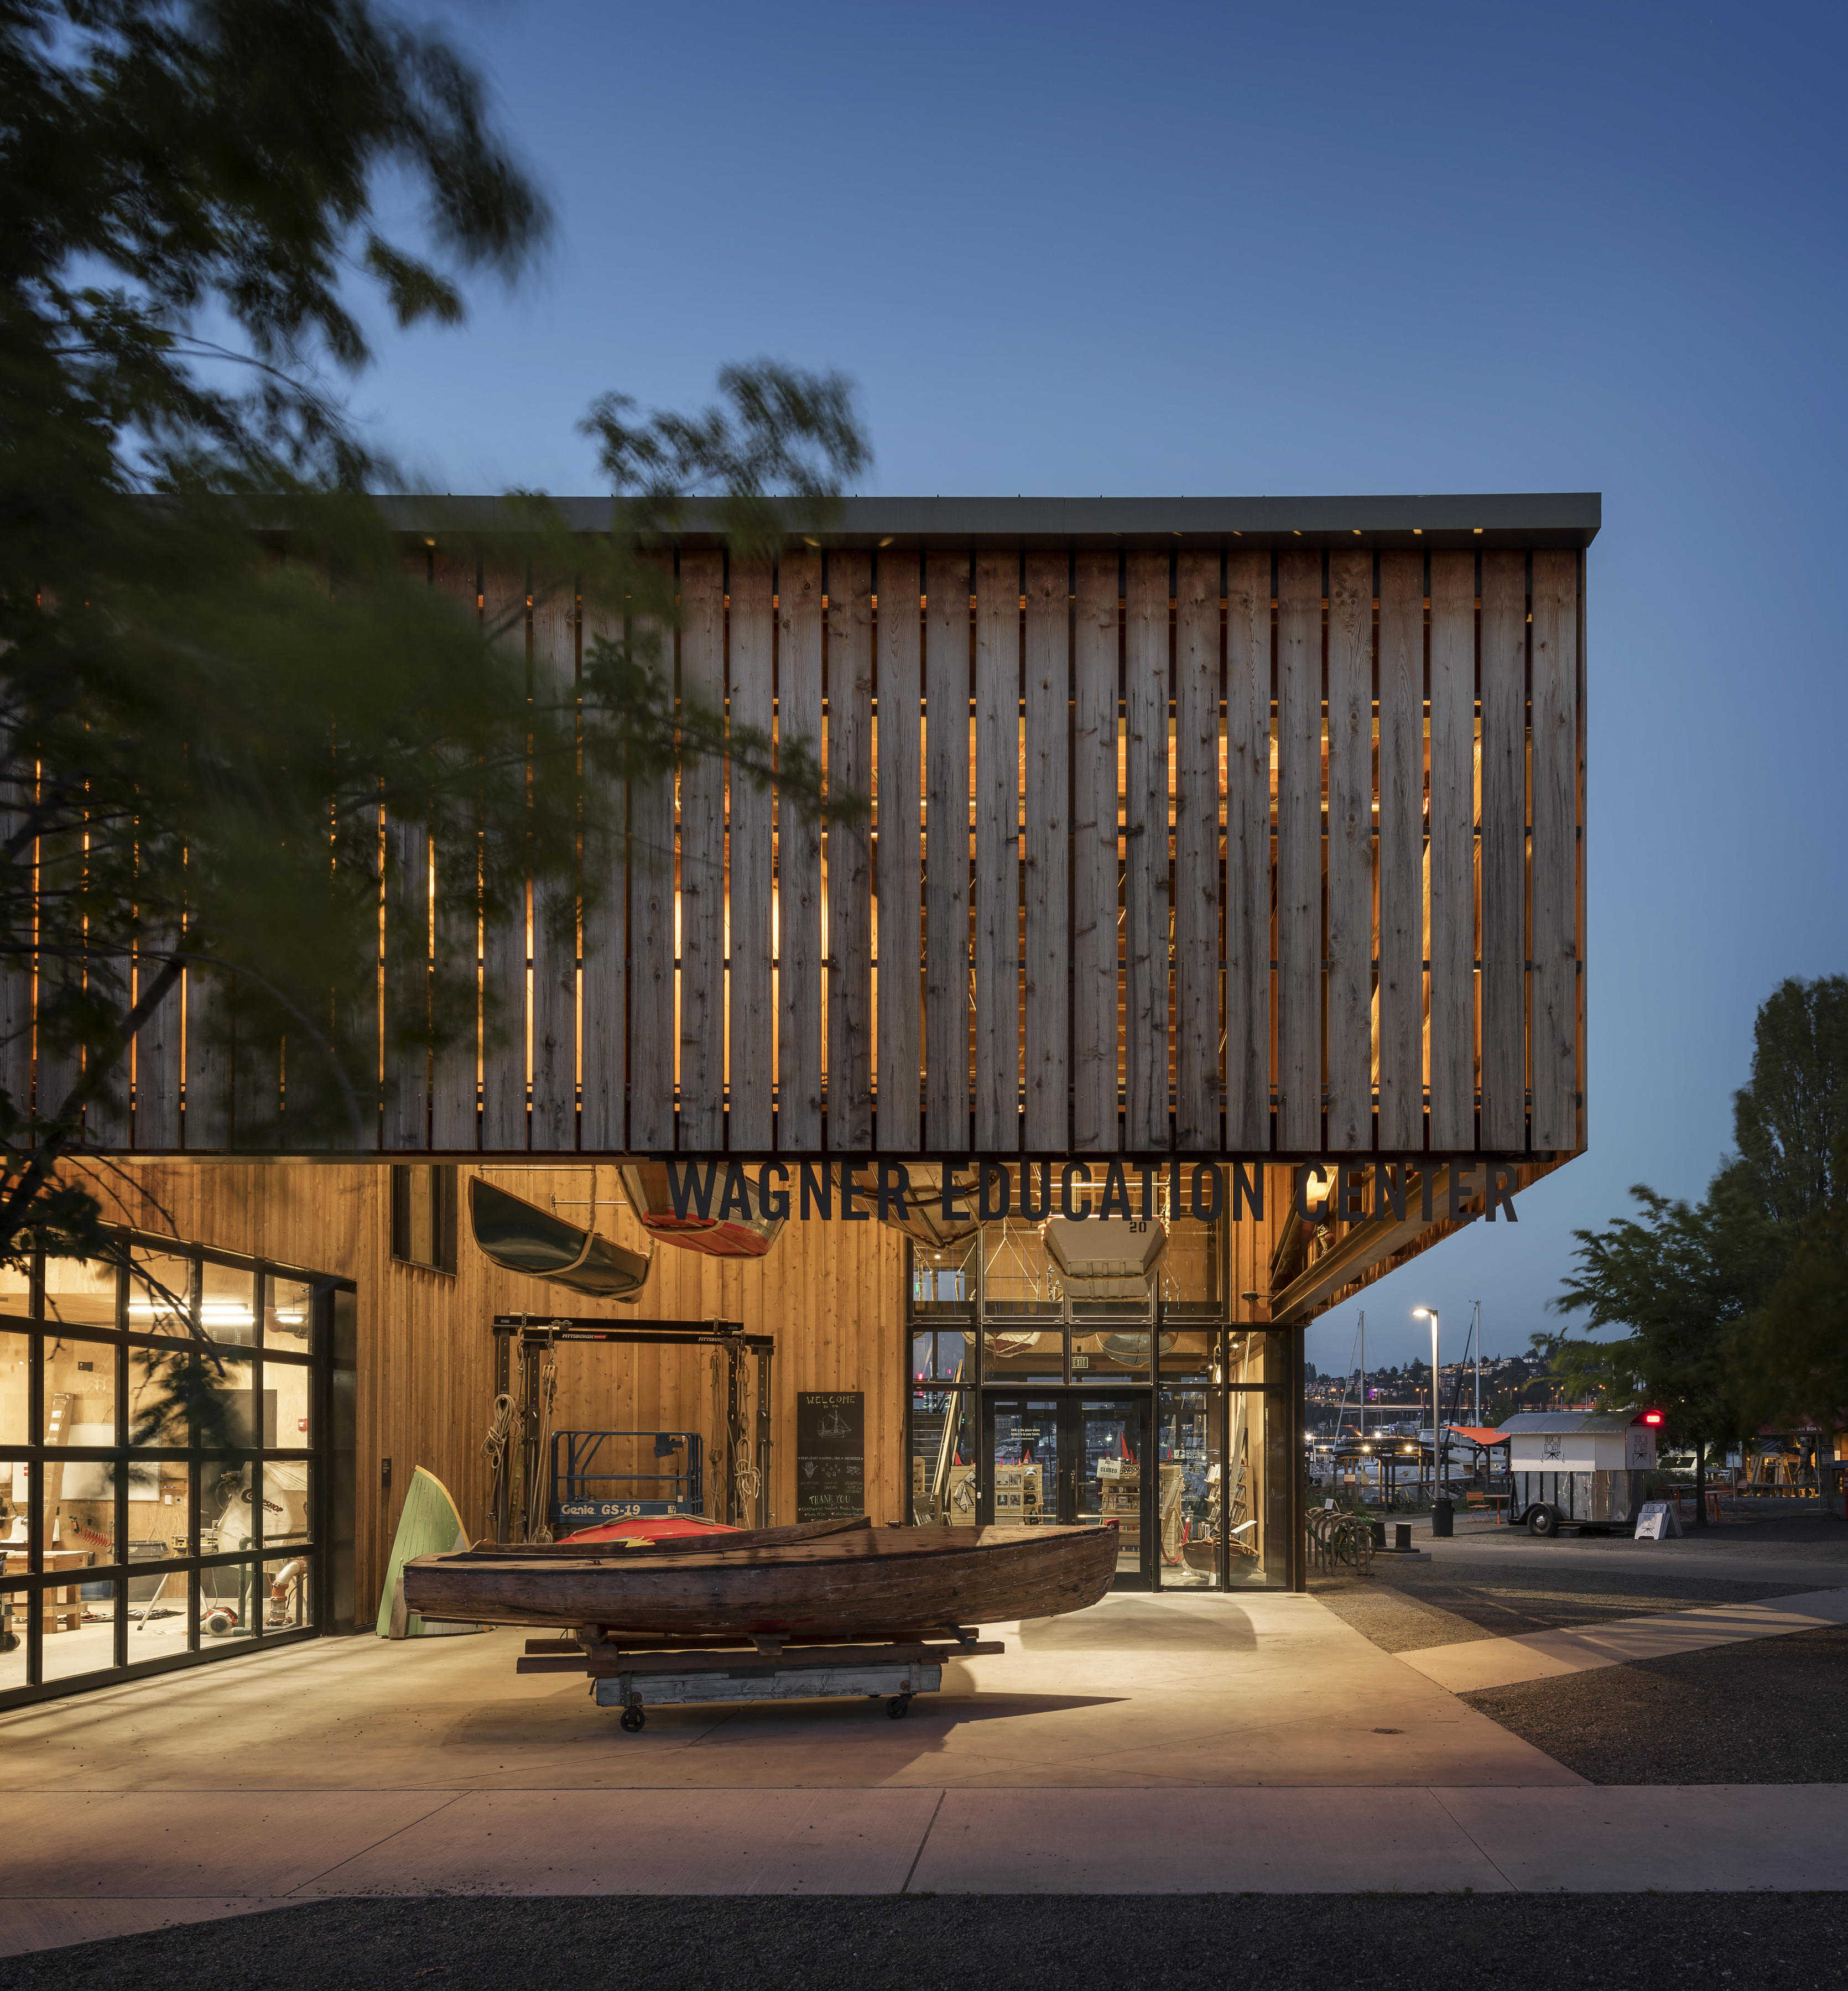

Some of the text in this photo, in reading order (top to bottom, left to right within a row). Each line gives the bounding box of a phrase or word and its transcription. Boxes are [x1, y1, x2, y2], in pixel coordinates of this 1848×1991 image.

[666, 1160, 1518, 1222] WAGNER EDUCATION CENTER
[1129, 1222, 1147, 1233] 20
[1073, 1358, 1085, 1367] EXIT
[806, 1395, 856, 1404] WELCOME
[809, 1494, 851, 1504] THANK YOU
[263, 1499, 284, 1513] SHOP
[561, 1504, 641, 1515] Genie GS-19
